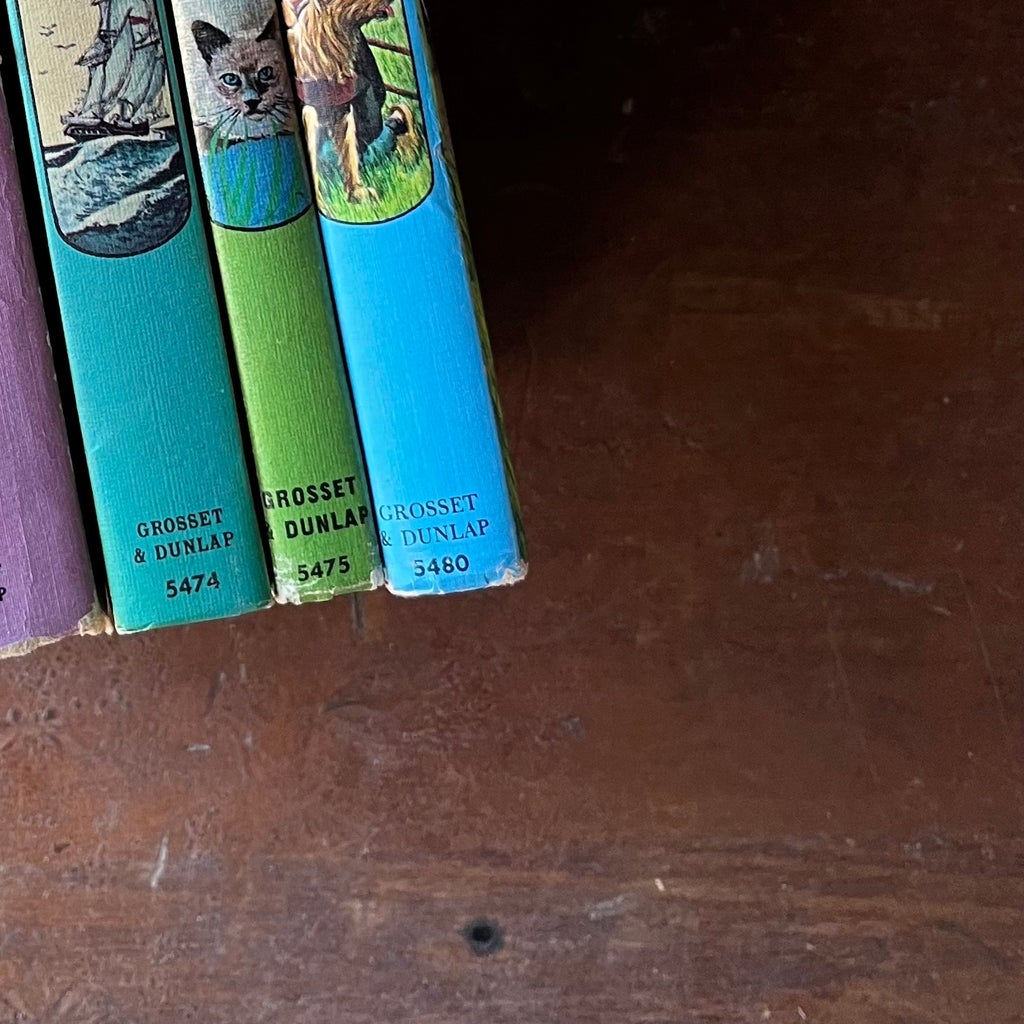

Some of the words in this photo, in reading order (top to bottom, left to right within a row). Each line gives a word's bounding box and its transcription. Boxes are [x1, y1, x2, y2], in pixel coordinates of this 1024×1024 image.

[262, 476, 355, 509] GROSSET
[379, 493, 478, 521] GROSSET
[136, 508, 223, 539] GROSSET
[285, 506, 368, 539] DUNLAP
[380, 530, 392, 547] &
[401, 519, 489, 546] DUNLAP
[134, 548, 146, 564] &
[155, 531, 234, 561] DUNLAP
[298, 555, 350, 582] 5475
[414, 554, 469, 576] 5480
[166, 571, 220, 598] 5474
